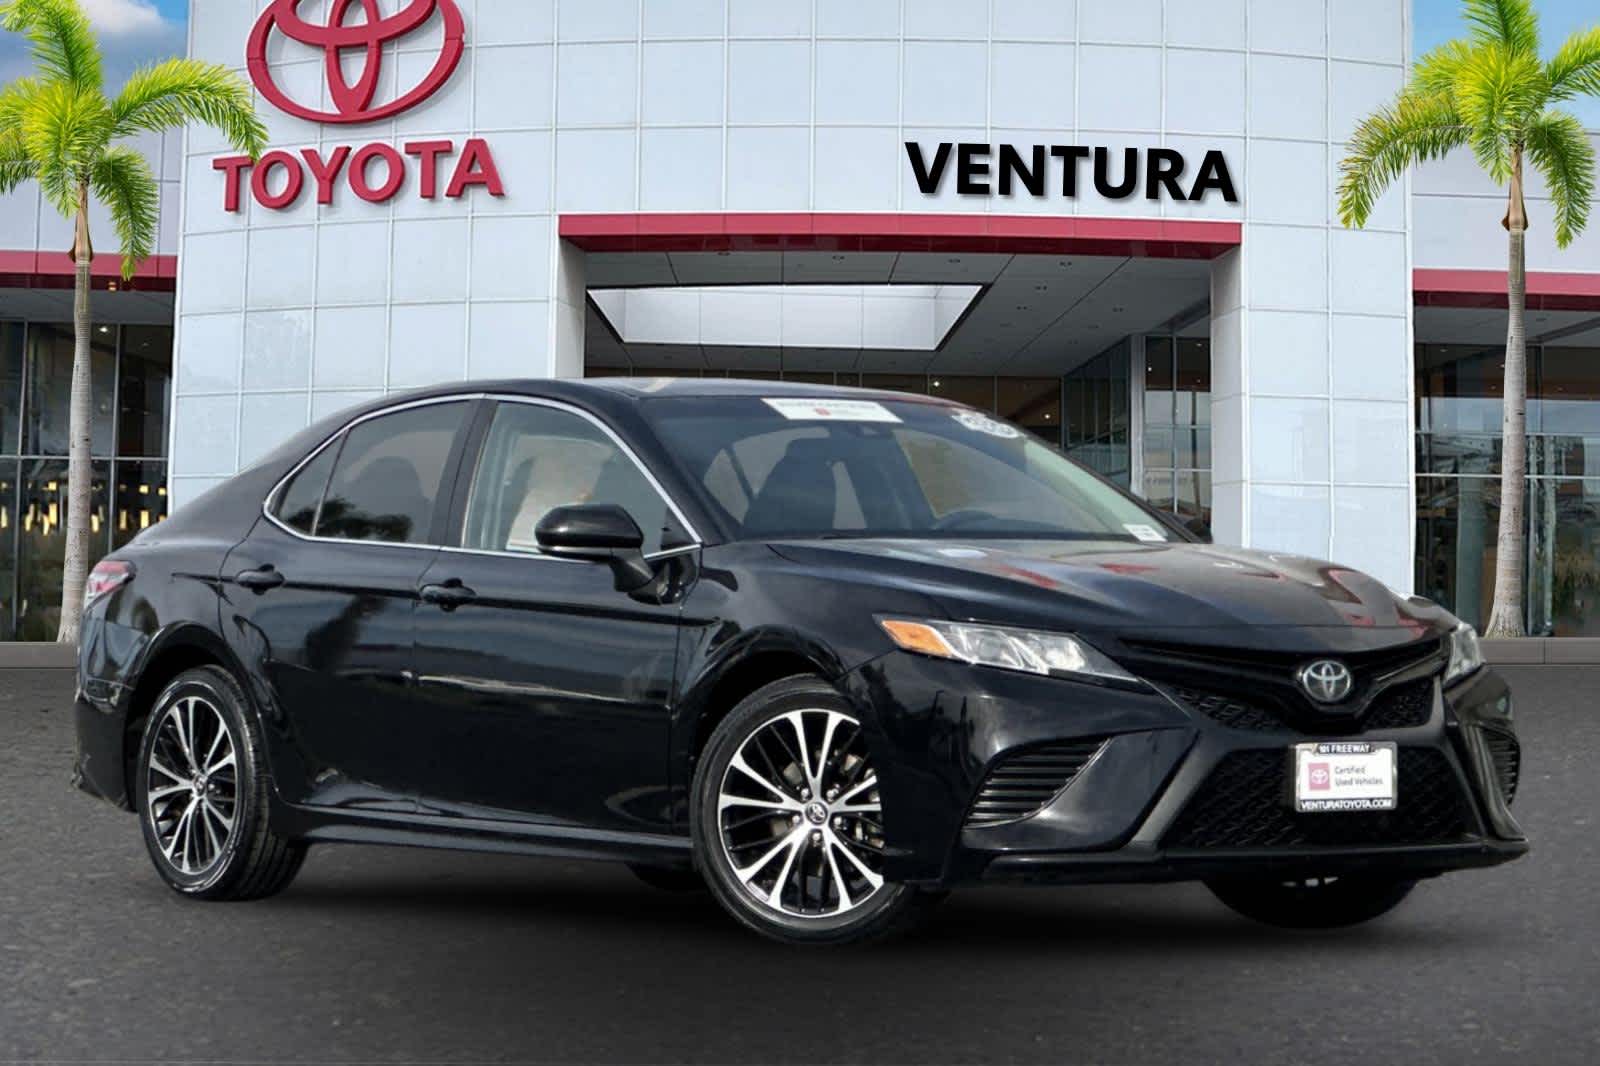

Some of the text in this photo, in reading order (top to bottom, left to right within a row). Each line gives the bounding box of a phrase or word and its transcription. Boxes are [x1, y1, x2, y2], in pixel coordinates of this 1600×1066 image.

[212, 138, 505, 212] TOYOTA
[904, 142, 1239, 203] VENTURA
[1331, 744, 1370, 753] FREEWAY
[1334, 766, 1366, 775] Certified
[1301, 799, 1392, 810] VENTURATOYOTA.COM
